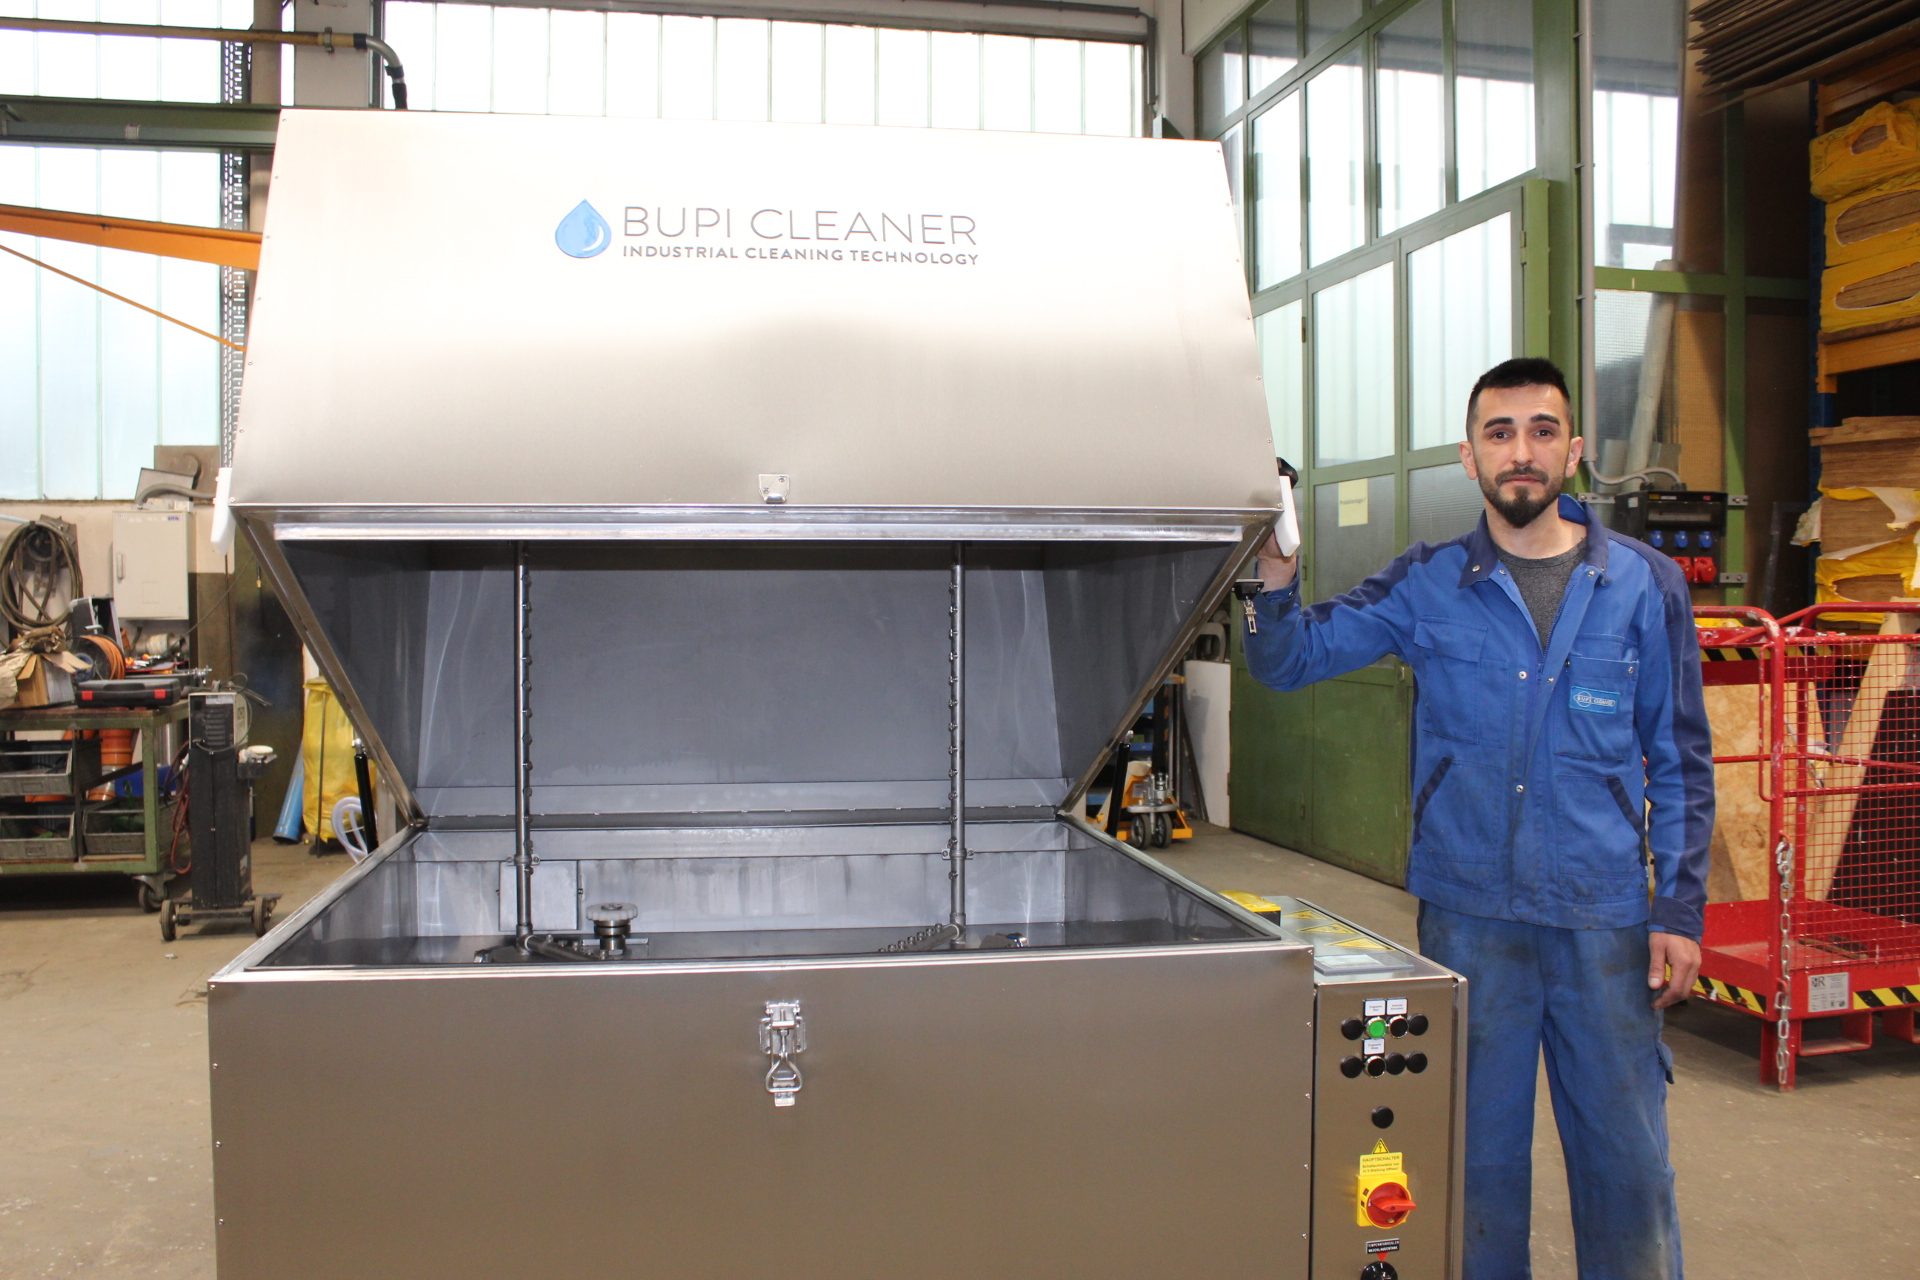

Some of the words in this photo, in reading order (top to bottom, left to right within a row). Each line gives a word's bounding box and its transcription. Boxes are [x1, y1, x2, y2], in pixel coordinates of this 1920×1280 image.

[624, 206, 731, 238] BUPI
[750, 208, 976, 246] CLEANER
[623, 245, 739, 259] INDUSTRIAL
[745, 247, 844, 262] CLEANING
[850, 250, 979, 266] TECHNOLOGY
